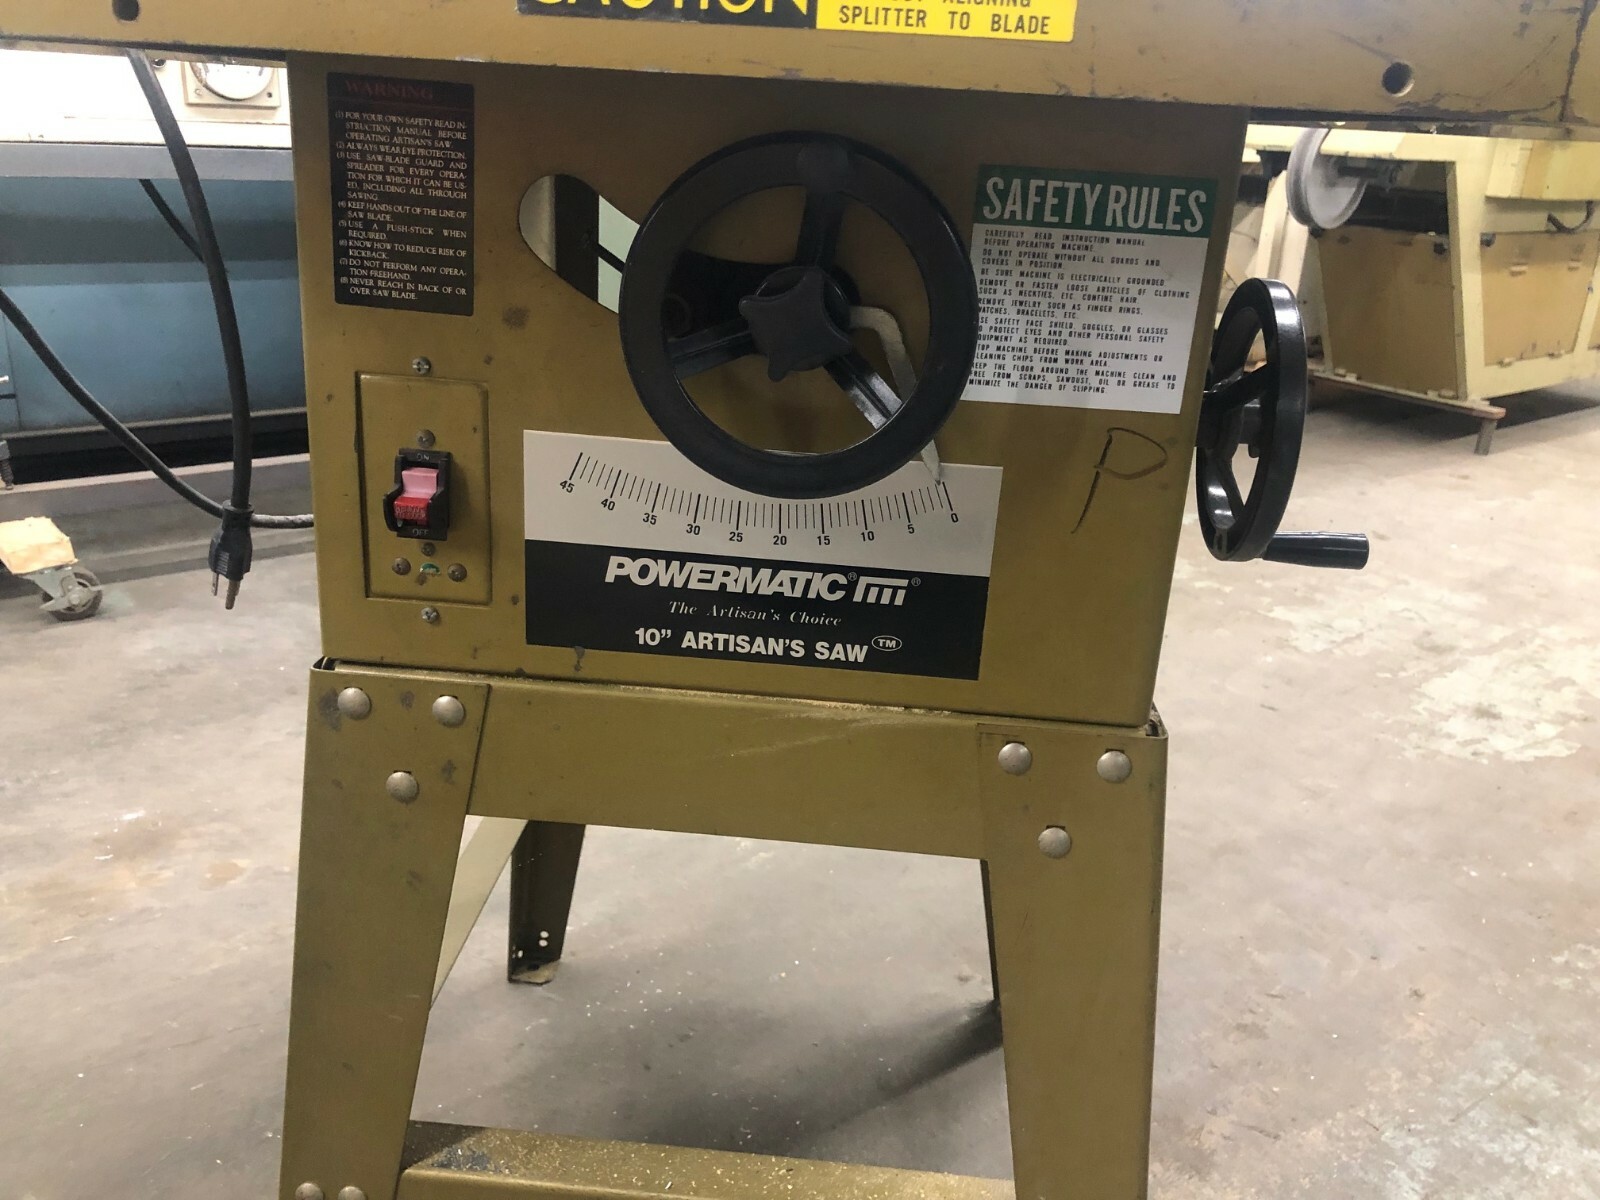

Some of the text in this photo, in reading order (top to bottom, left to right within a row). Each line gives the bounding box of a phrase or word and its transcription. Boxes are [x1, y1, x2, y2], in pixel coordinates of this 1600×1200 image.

[839, 6, 1051, 35] SPLITTER TO BLADE
[363, 113, 383, 122] YOUR
[406, 117, 433, 126] SAFETY
[435, 119, 455, 128] READ
[346, 122, 467, 140] STRUCTION MANUAL BEFORE
[346, 132, 390, 142] OPERATING
[346, 142, 377, 151] ALWAYS
[416, 159, 444, 167] GUARD
[347, 162, 434, 177] SPREADER FOR EVERY
[347, 172, 365, 180] TION
[386, 176, 412, 185] WHICH
[424, 179, 440, 187] CAN
[363, 183, 405, 193] INCLUDING
[428, 189, 466, 199] THROUGH
[982, 176, 1207, 233] SAFETY RULES
[366, 204, 392, 212] HANDS
[439, 210, 454, 218] LINE
[443, 229, 466, 238] WHEN
[1062, 234, 1110, 244] INSTRUCTION
[407, 245, 437, 254] REDUCE
[438, 248, 454, 256] RISK
[1055, 253, 1086, 262] WITHOUT
[383, 262, 417, 271] PERFORM
[1071, 274, 1120, 283] ELECTRICALLY
[350, 278, 374, 286] NEVER
[378, 280, 403, 289] REACH
[419, 284, 438, 292] BACK
[350, 287, 370, 295] OVER
[1096, 286, 1130, 295] ARTICLES
[1155, 290, 1190, 298] CLOTHING
[989, 326, 1019, 334] PROTECT
[1069, 331, 1091, 339] OTHER
[1097, 332, 1132, 341] PERSONAL
[1137, 327, 1168, 335] GLASSES
[996, 345, 1027, 353] MACHINE
[1065, 349, 1092, 357] MAKING
[1098, 352, 1148, 361] ADJUSTMENTS
[1041, 367, 1068, 375] AROUND
[1095, 370, 1126, 378] MACHINE
[969, 379, 1000, 387] MINIMIZE
[1025, 382, 1052, 390] DANGER
[1070, 427, 1168, 534] P
[560, 480, 574, 494] 45
[601, 498, 615, 511] 40
[643, 513, 657, 525] 35
[951, 513, 959, 523] 0
[412, 528, 429, 536] OFF
[686, 524, 700, 536] 30
[908, 524, 914, 534] 5
[729, 532, 743, 543] 25
[773, 536, 787, 546] 20
[817, 536, 830, 545] 15
[861, 531, 874, 541] 10
[669, 601, 841, 626] The Artisan's Choice
[635, 628, 896, 663] 10" ARTISAN'S SAW TM
